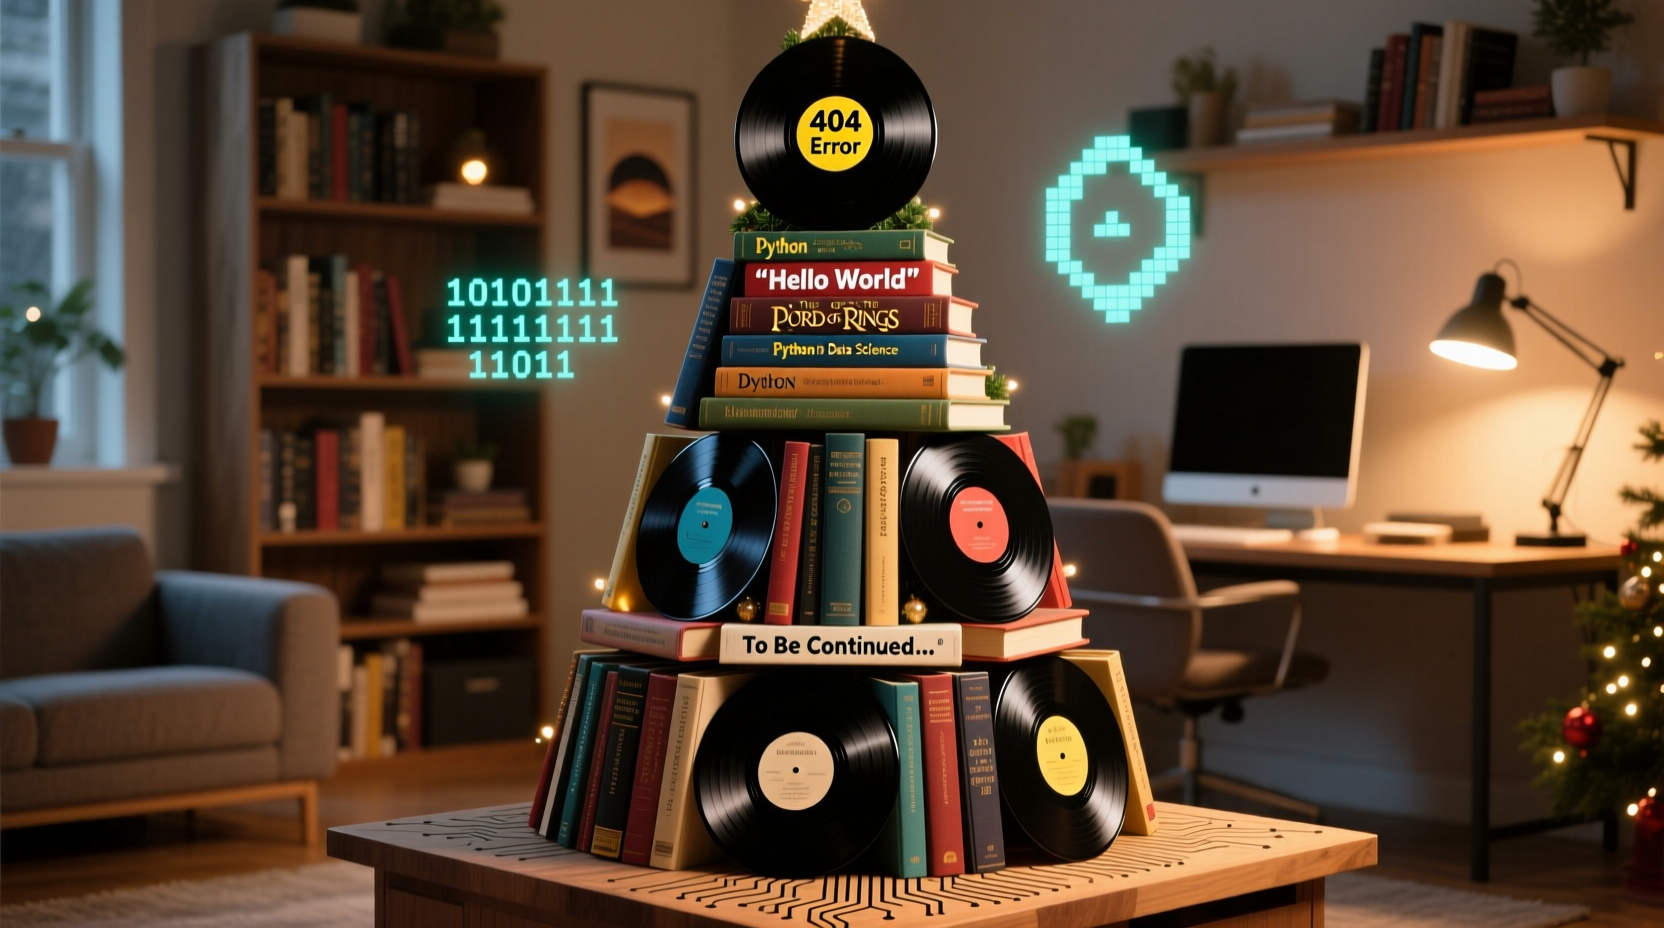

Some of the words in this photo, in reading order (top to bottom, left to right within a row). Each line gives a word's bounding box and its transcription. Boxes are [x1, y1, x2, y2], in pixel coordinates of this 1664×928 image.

[810, 109, 861, 132] 404
[810, 137, 861, 154] Error
[756, 237, 807, 259] Python
[447, 278, 618, 306] 10101111
[447, 314, 618, 343] 11111111
[469, 350, 574, 379] 11011
[742, 635, 767, 654] To
[774, 635, 801, 655] Be
